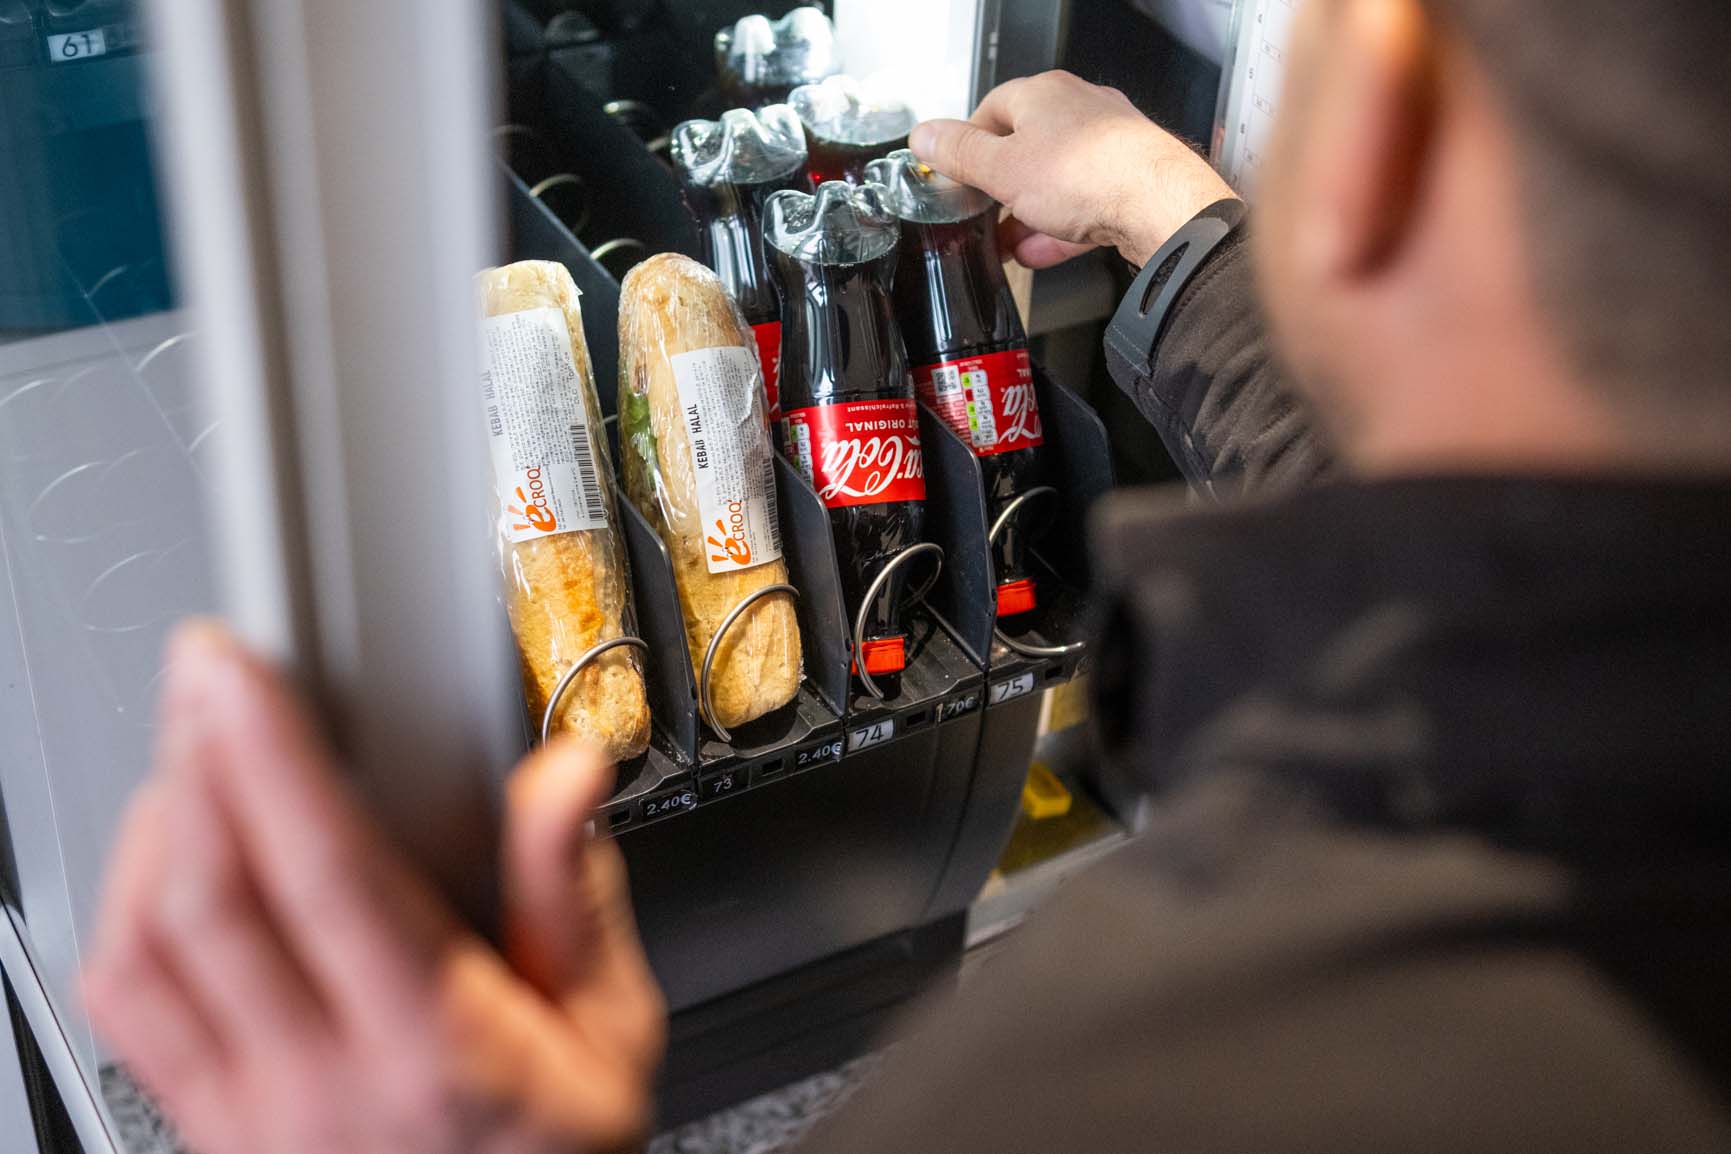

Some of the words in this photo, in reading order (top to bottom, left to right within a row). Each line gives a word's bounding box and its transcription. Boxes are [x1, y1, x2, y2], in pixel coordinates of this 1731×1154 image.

[62, 34, 92, 58] 61
[487, 404, 504, 437] KEBAB
[687, 404, 702, 433] HALAL
[845, 419, 906, 433] ORIGINAL
[694, 439, 709, 469] KEBAB
[998, 678, 1023, 699] 75
[856, 725, 884, 747] 74
[798, 742, 842, 765] 2.40€
[713, 778, 733, 793] 73
[647, 793, 692, 816] 2.40€
